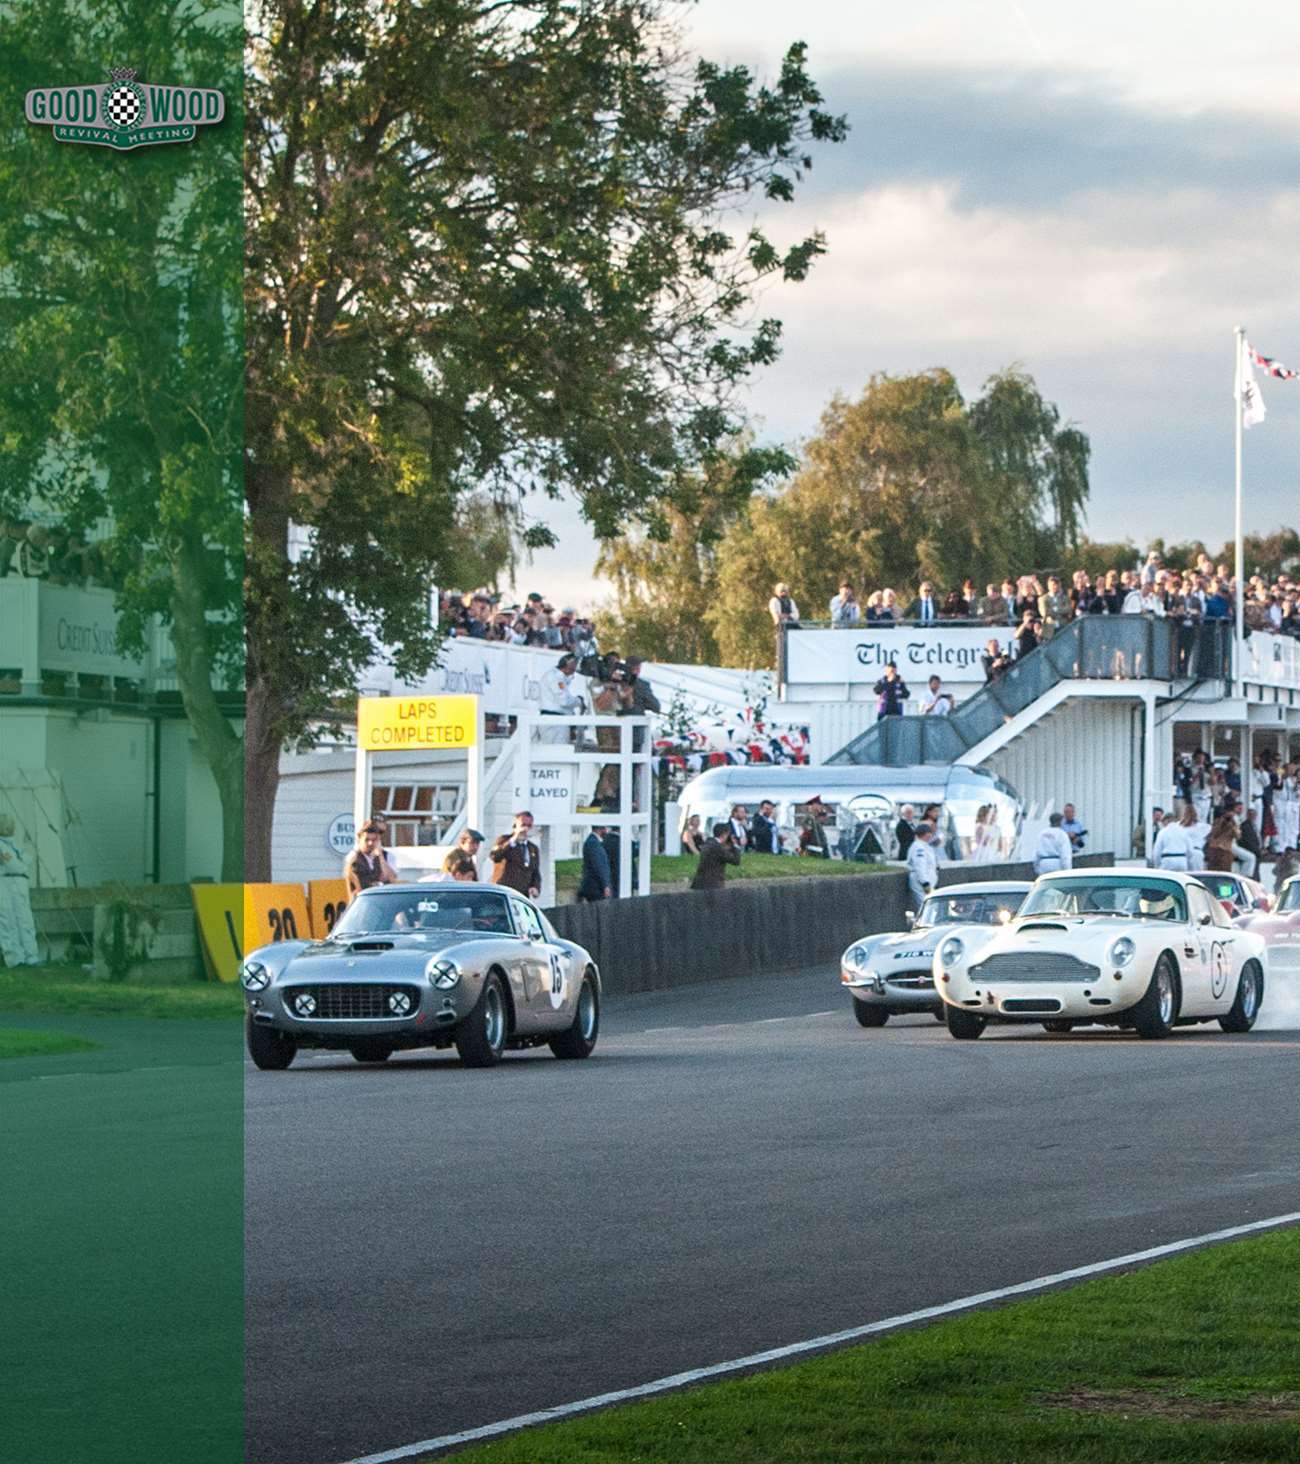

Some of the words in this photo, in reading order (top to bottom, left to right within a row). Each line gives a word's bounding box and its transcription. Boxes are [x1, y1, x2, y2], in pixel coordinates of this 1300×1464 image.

[856, 643, 899, 665] The
[907, 642, 1018, 669] Telegrh
[399, 702, 437, 719] LAPS
[370, 725, 465, 744] COMPLETED
[531, 769, 560, 779] TART
[514, 787, 568, 797] DLAYED
[337, 823, 354, 833] BU
[333, 836, 354, 846] STO
